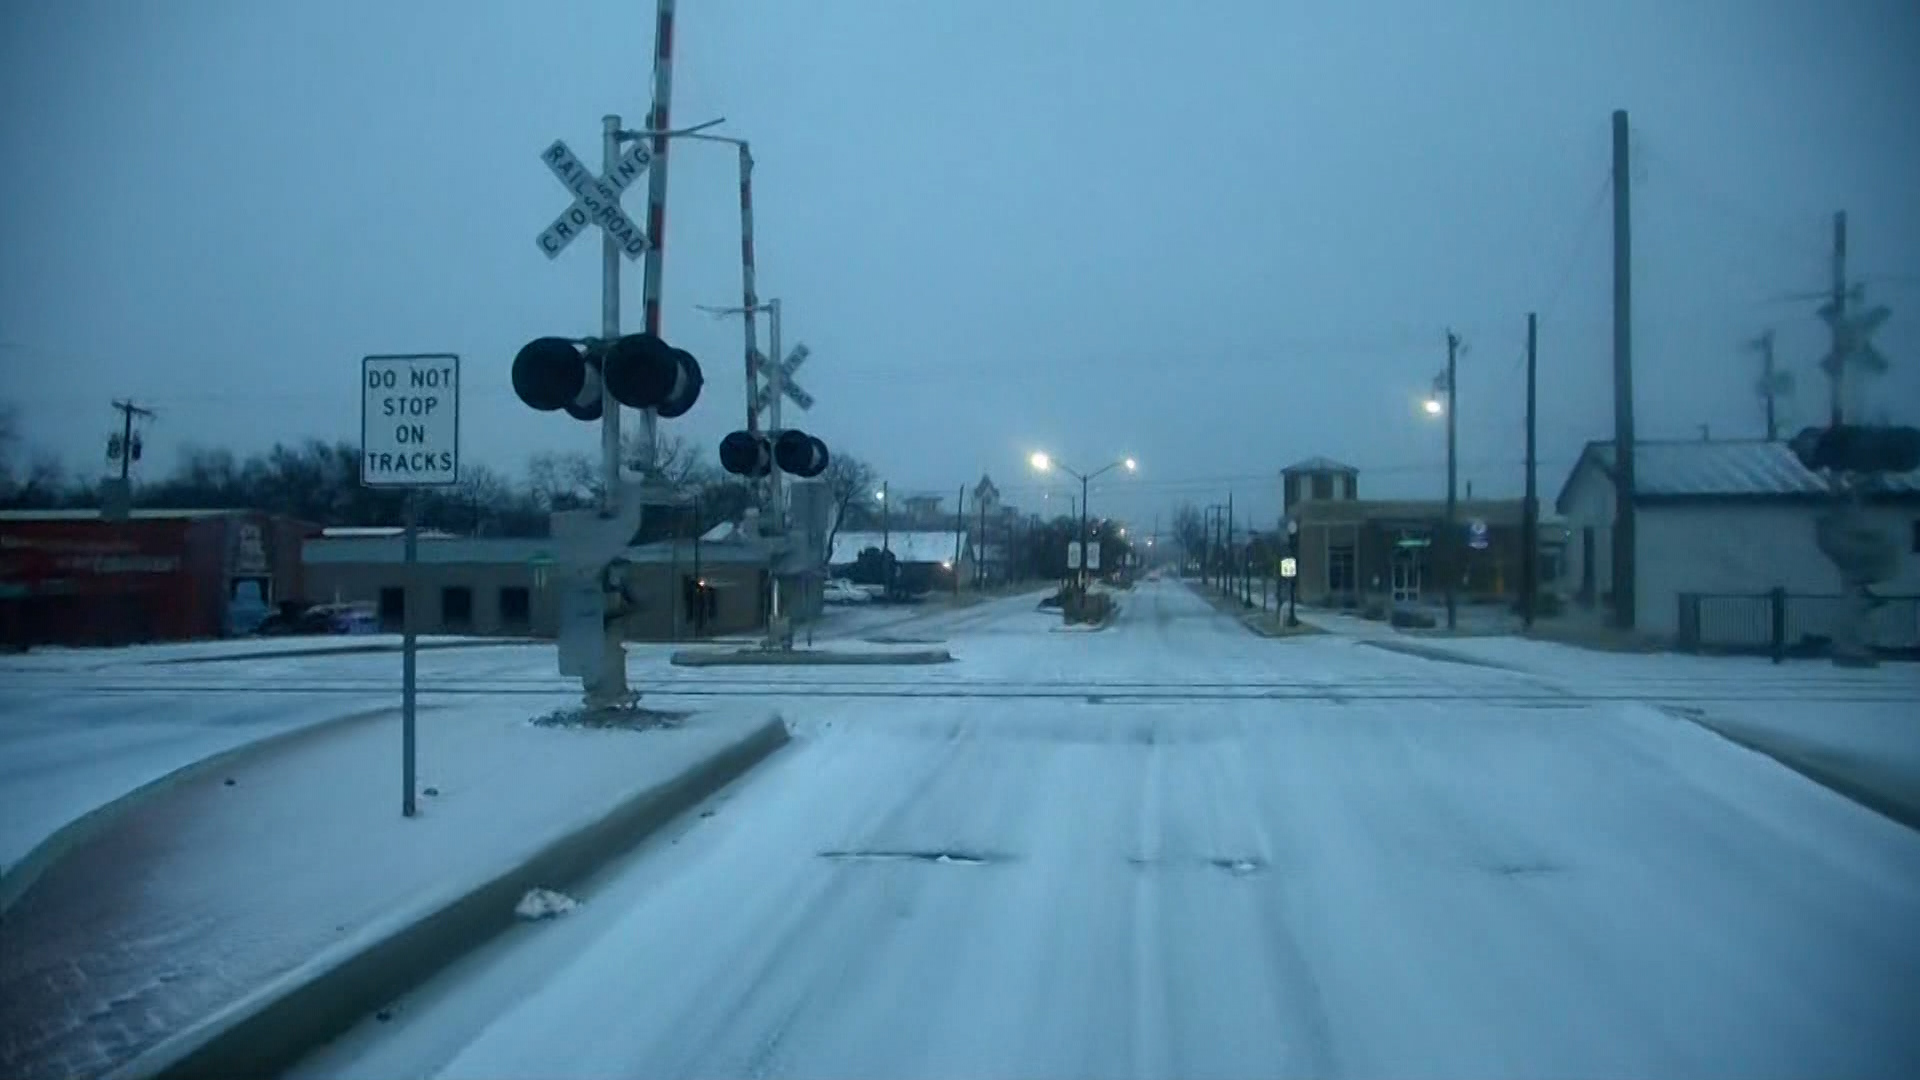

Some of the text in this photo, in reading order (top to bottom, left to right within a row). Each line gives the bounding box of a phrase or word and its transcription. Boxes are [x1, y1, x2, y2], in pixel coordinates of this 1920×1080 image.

[368, 367, 451, 389] DO NOT
[383, 396, 438, 417] STOP
[395, 424, 425, 445] ON
[367, 452, 452, 472] TRACKS
